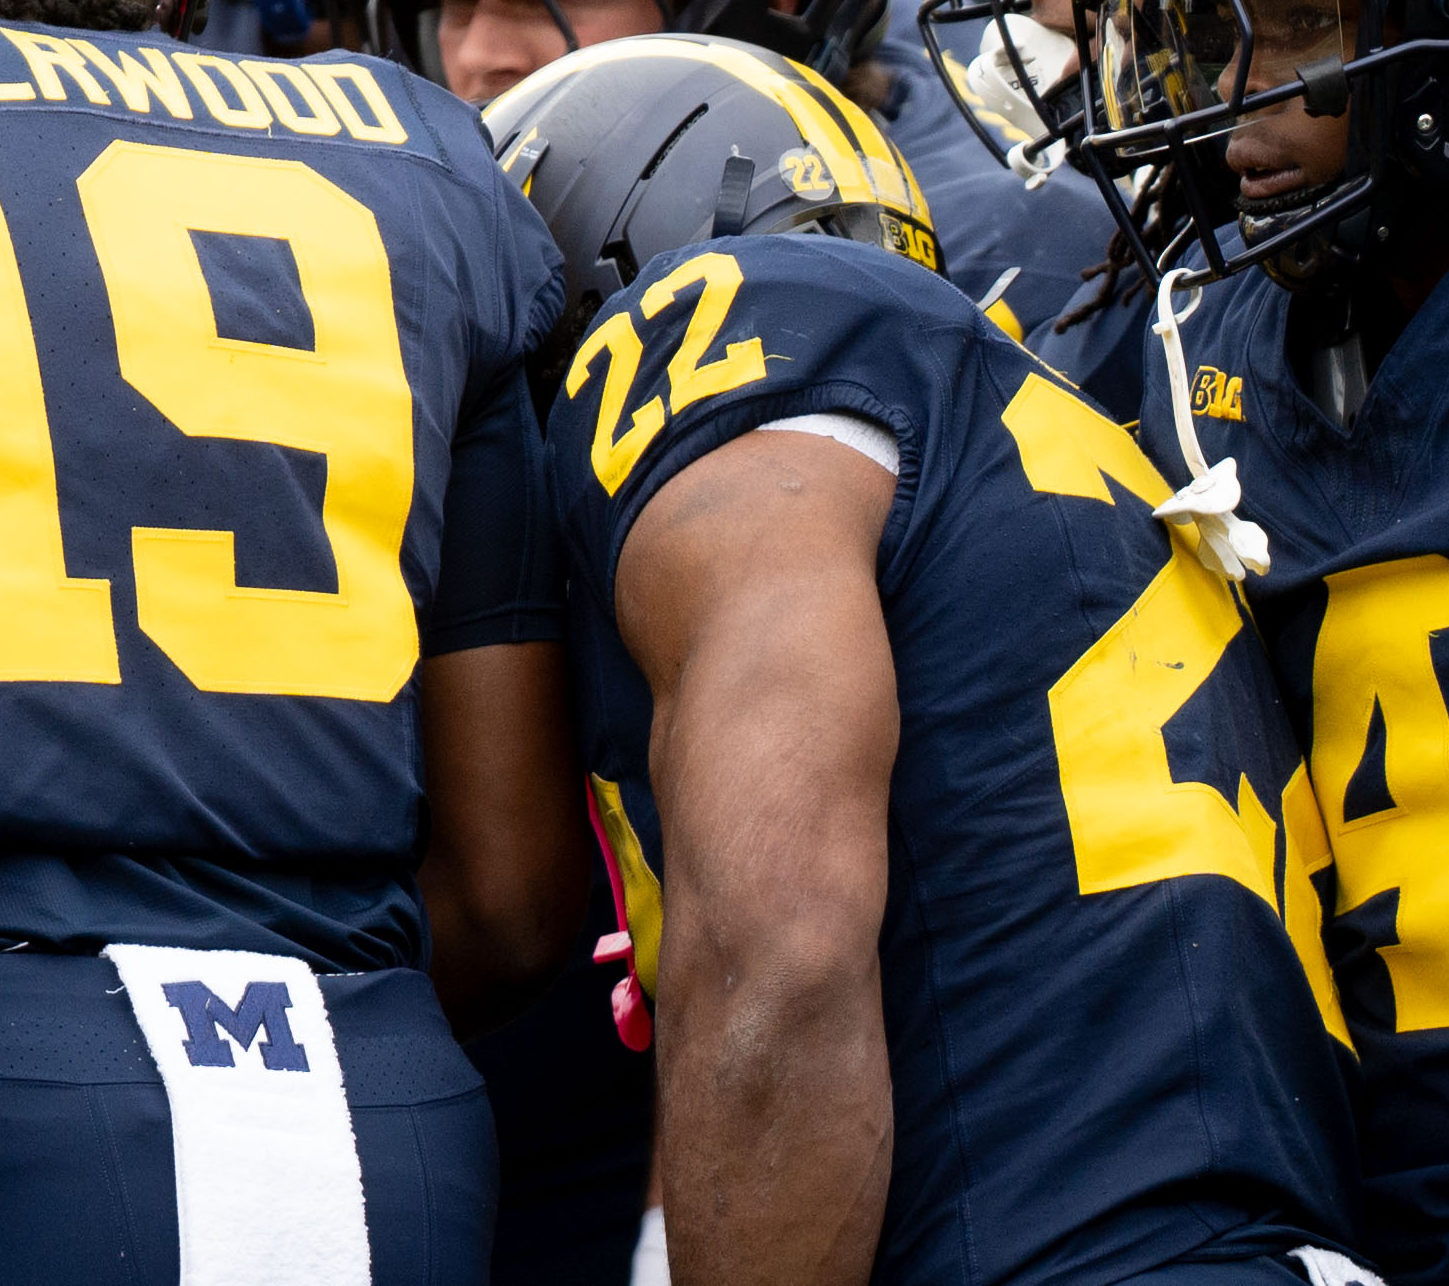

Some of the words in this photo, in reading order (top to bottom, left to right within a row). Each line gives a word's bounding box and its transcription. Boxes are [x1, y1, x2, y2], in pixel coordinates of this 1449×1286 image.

[784, 156, 830, 191] 22
[566, 252, 767, 497] 22
[161, 980, 310, 1072] M
